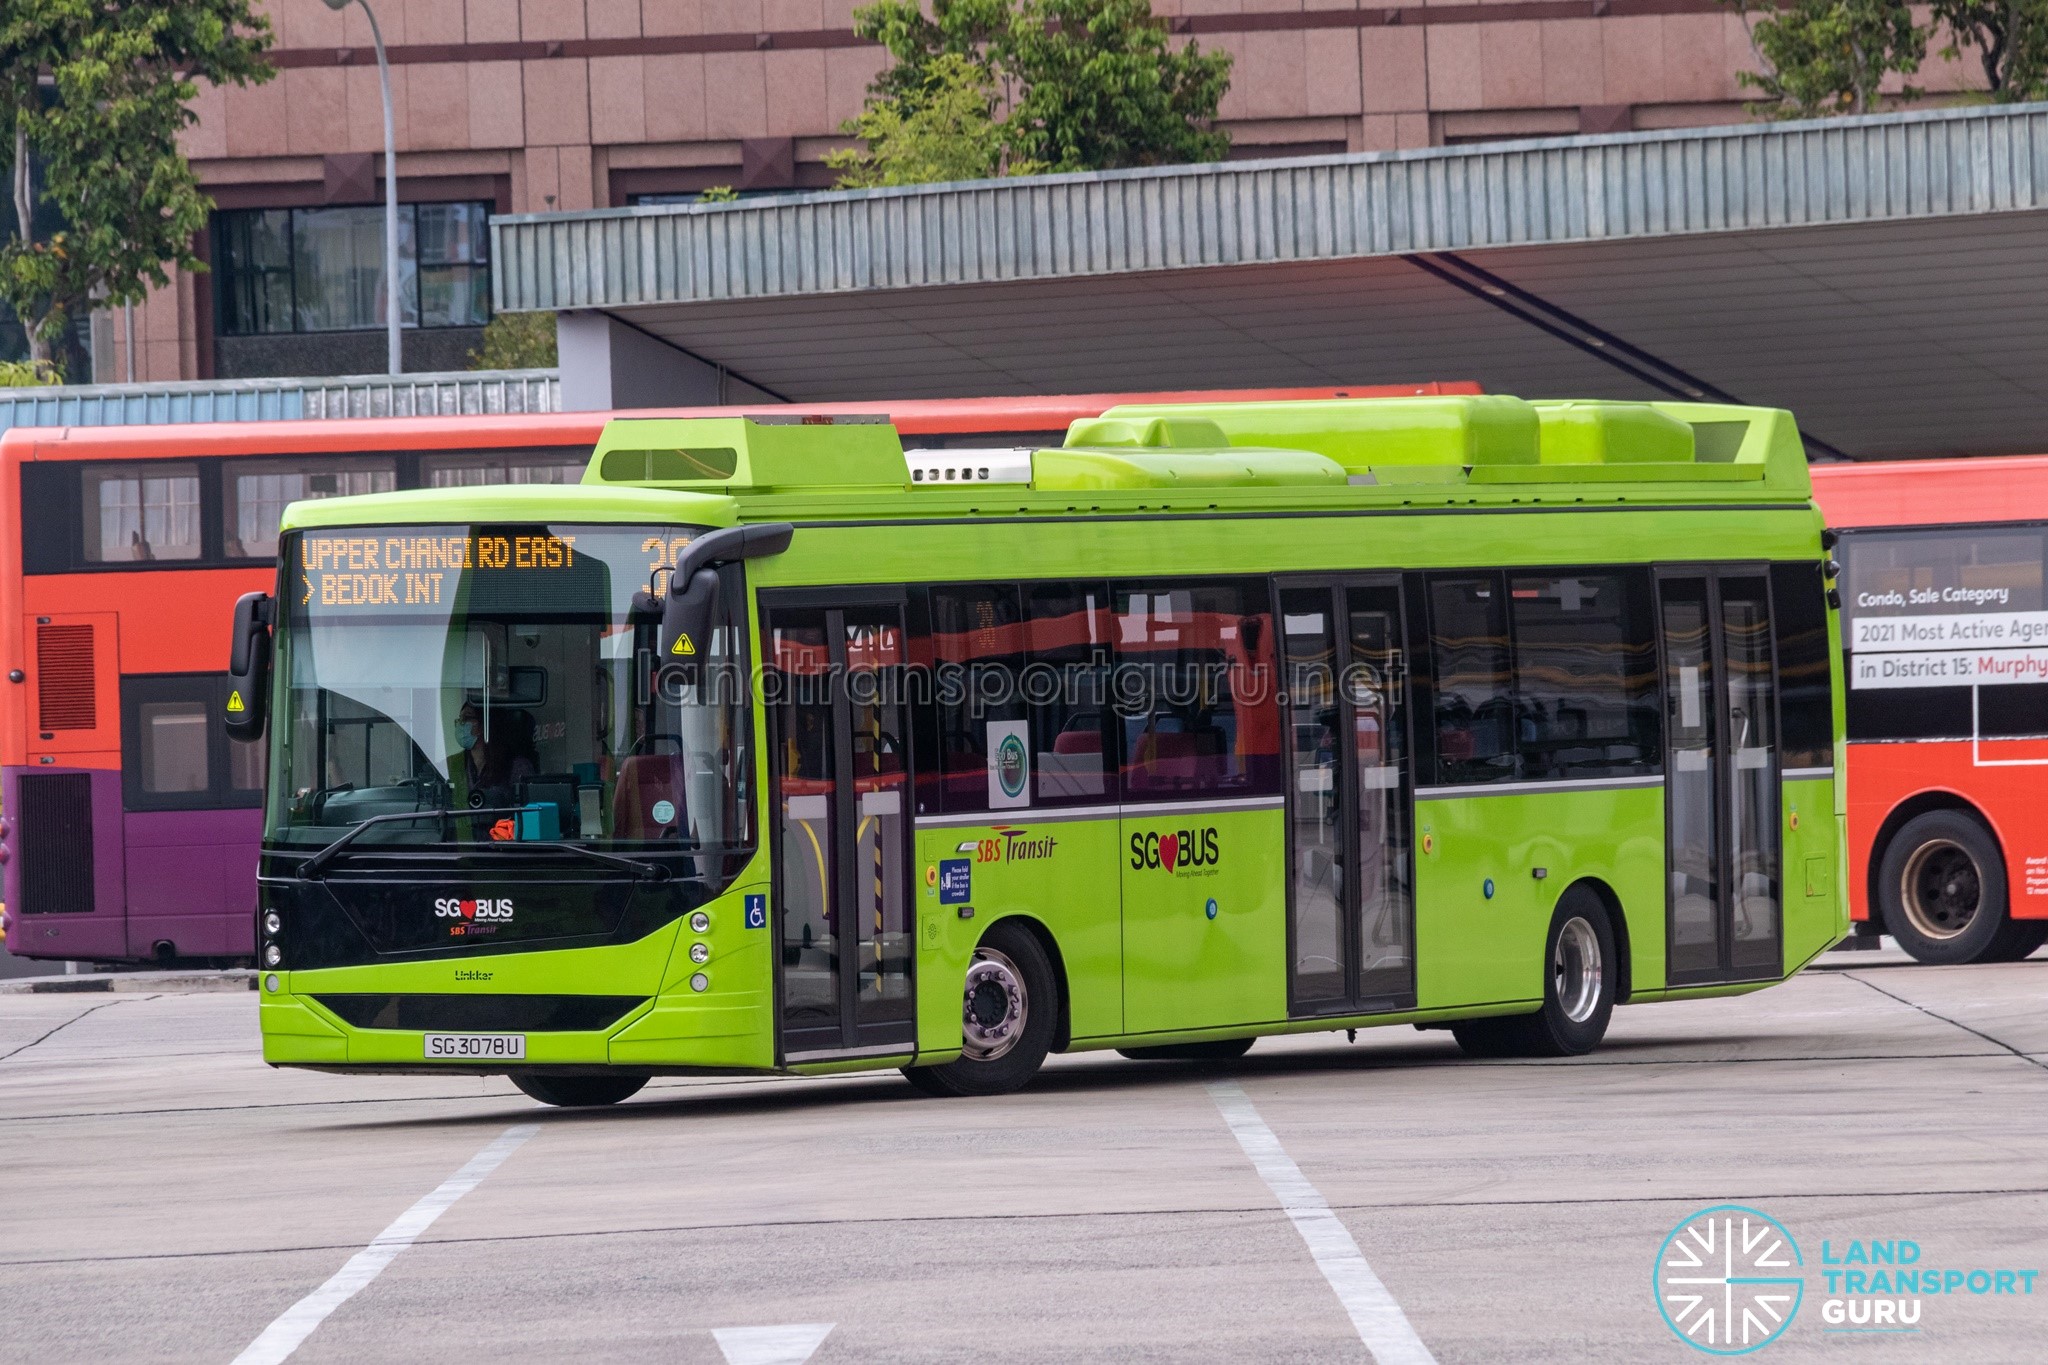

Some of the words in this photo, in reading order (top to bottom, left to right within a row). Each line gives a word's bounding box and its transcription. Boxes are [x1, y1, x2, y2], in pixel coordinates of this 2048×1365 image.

[302, 539, 379, 570] UPPER
[385, 538, 472, 569] CHANGI
[478, 537, 509, 568] RD
[515, 536, 576, 568] EAST
[321, 573, 399, 605] BEDOK
[405, 573, 443, 604] INT
[1857, 589, 1906, 608] Condo,
[1909, 587, 1940, 604] Sale
[1942, 586, 2009, 606] Category
[1860, 624, 1895, 642] 2021
[1901, 623, 1944, 641] Most
[1950, 619, 2004, 639] Active
[1860, 660, 1876, 678] in
[1882, 659, 1947, 678] District
[1952, 657, 1973, 675] 15:
[1977, 653, 2048, 678] Murphy
[977, 838, 1001, 863] SBS
[999, 830, 1059, 866] Transit
[1130, 832, 1160, 870] SG
[1177, 827, 1219, 867] BUS
[434, 898, 461, 917] SG
[475, 898, 514, 917] BUS
[450, 926, 465, 936] SBS
[464, 924, 498, 936] Transit
[455, 970, 493, 980] Linkker
[432, 1037, 518, 1055] SG3078U
